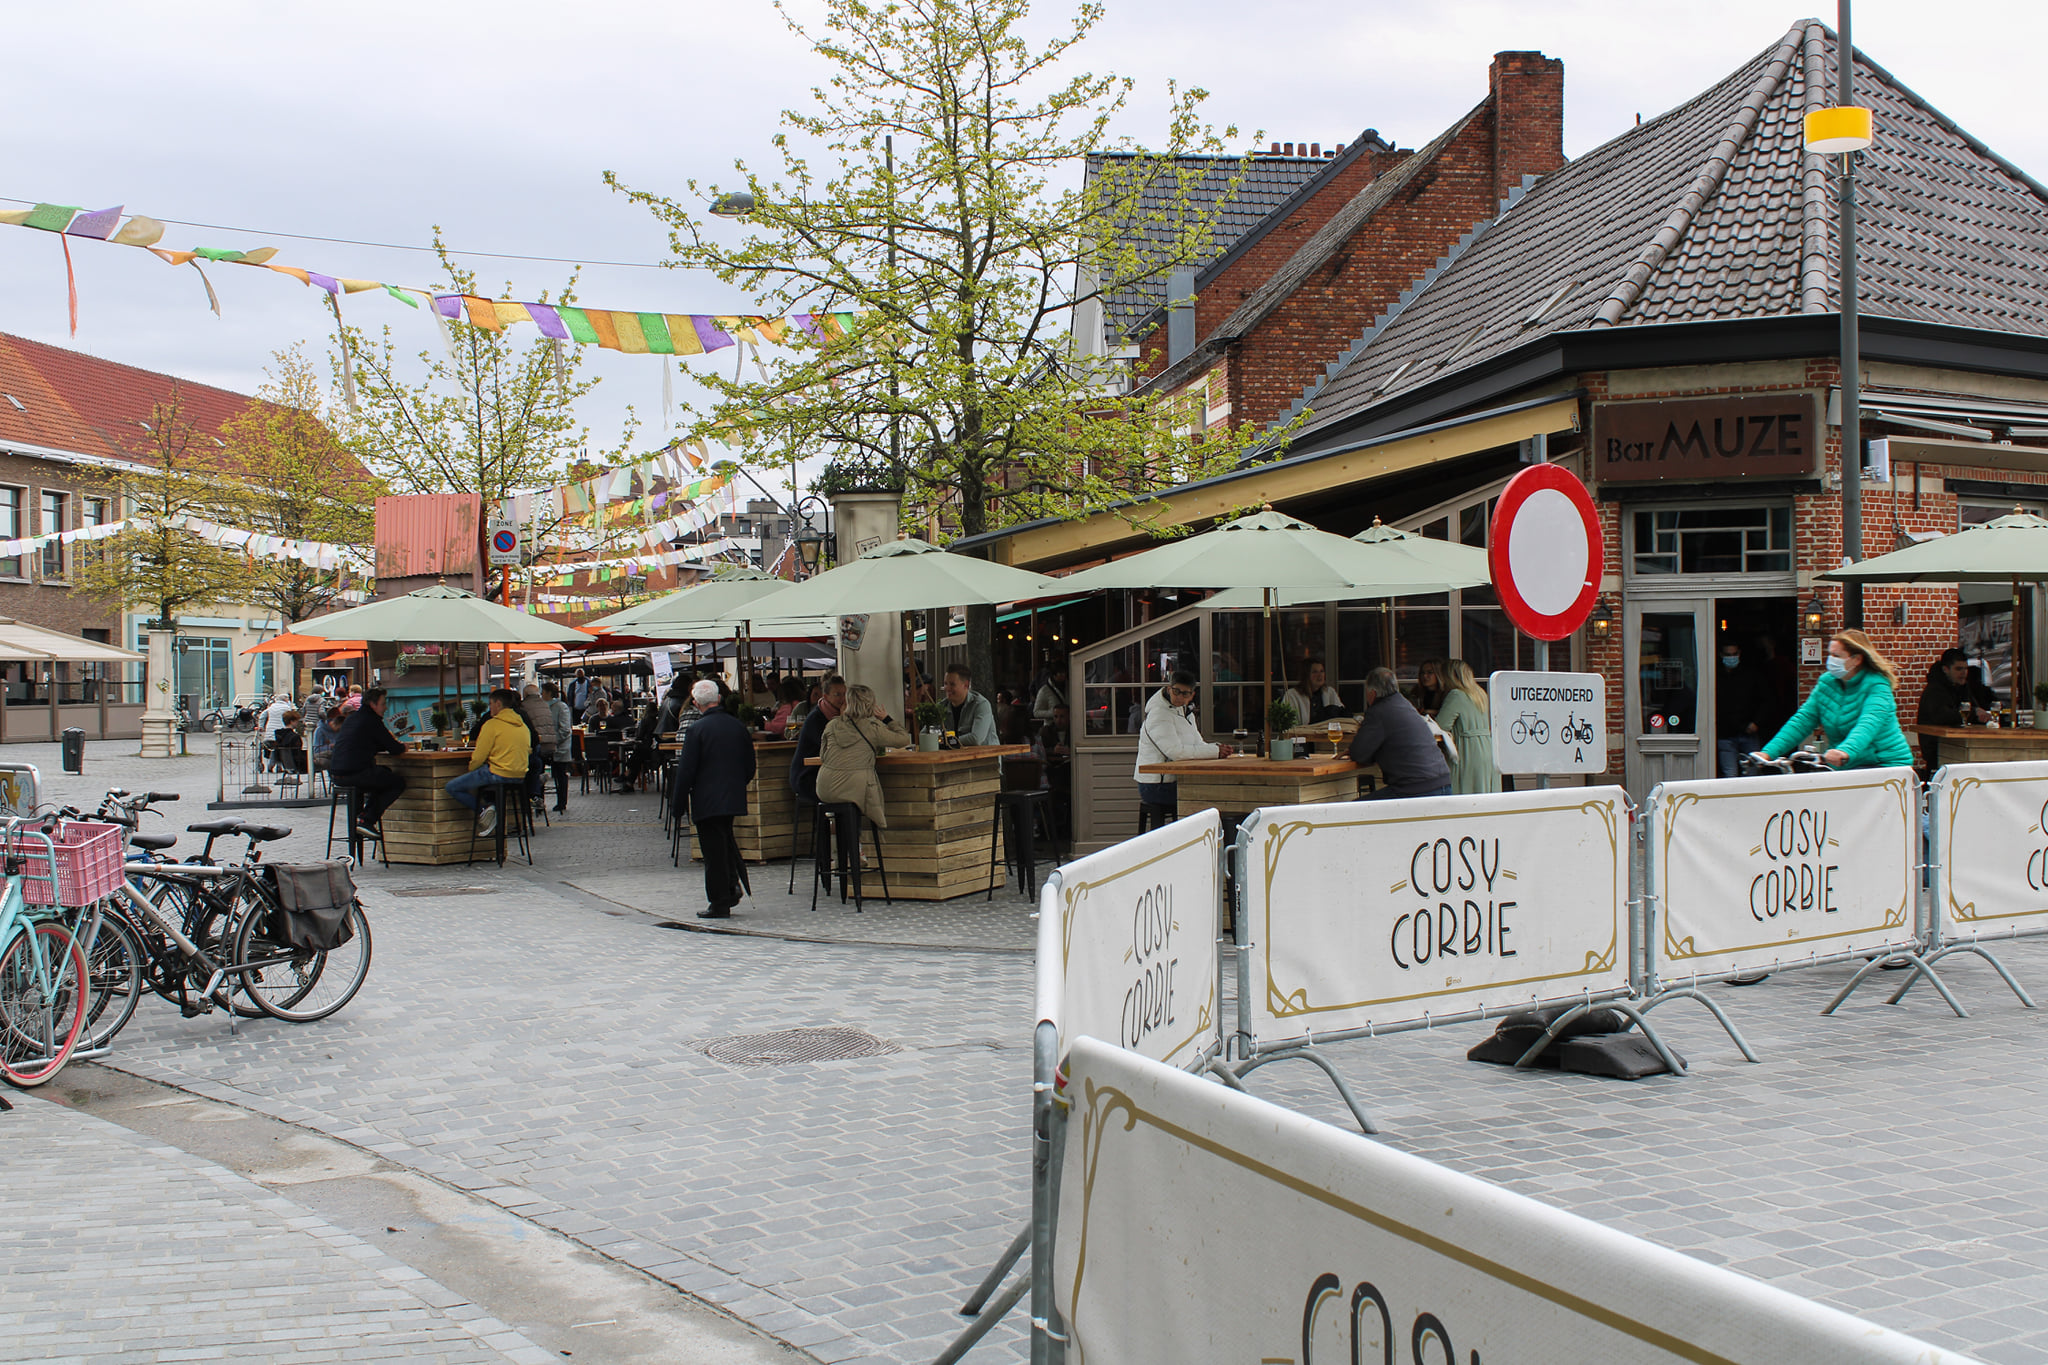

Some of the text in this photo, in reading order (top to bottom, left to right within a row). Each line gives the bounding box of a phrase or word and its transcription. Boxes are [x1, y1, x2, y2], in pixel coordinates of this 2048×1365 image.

[1607, 414, 1803, 463] Bar MUZE
[1807, 648, 1816, 656] 47
[1510, 686, 1594, 702] UITGEZONDERD
[1574, 746, 1584, 763] A
[1763, 808, 1828, 862] COSY
[1410, 836, 1501, 899] COSY
[1749, 863, 1839, 922] CORBIE
[1133, 883, 1173, 965] COSY
[1390, 899, 1519, 972] CORBIE
[1121, 958, 1178, 1049] CORBIE
